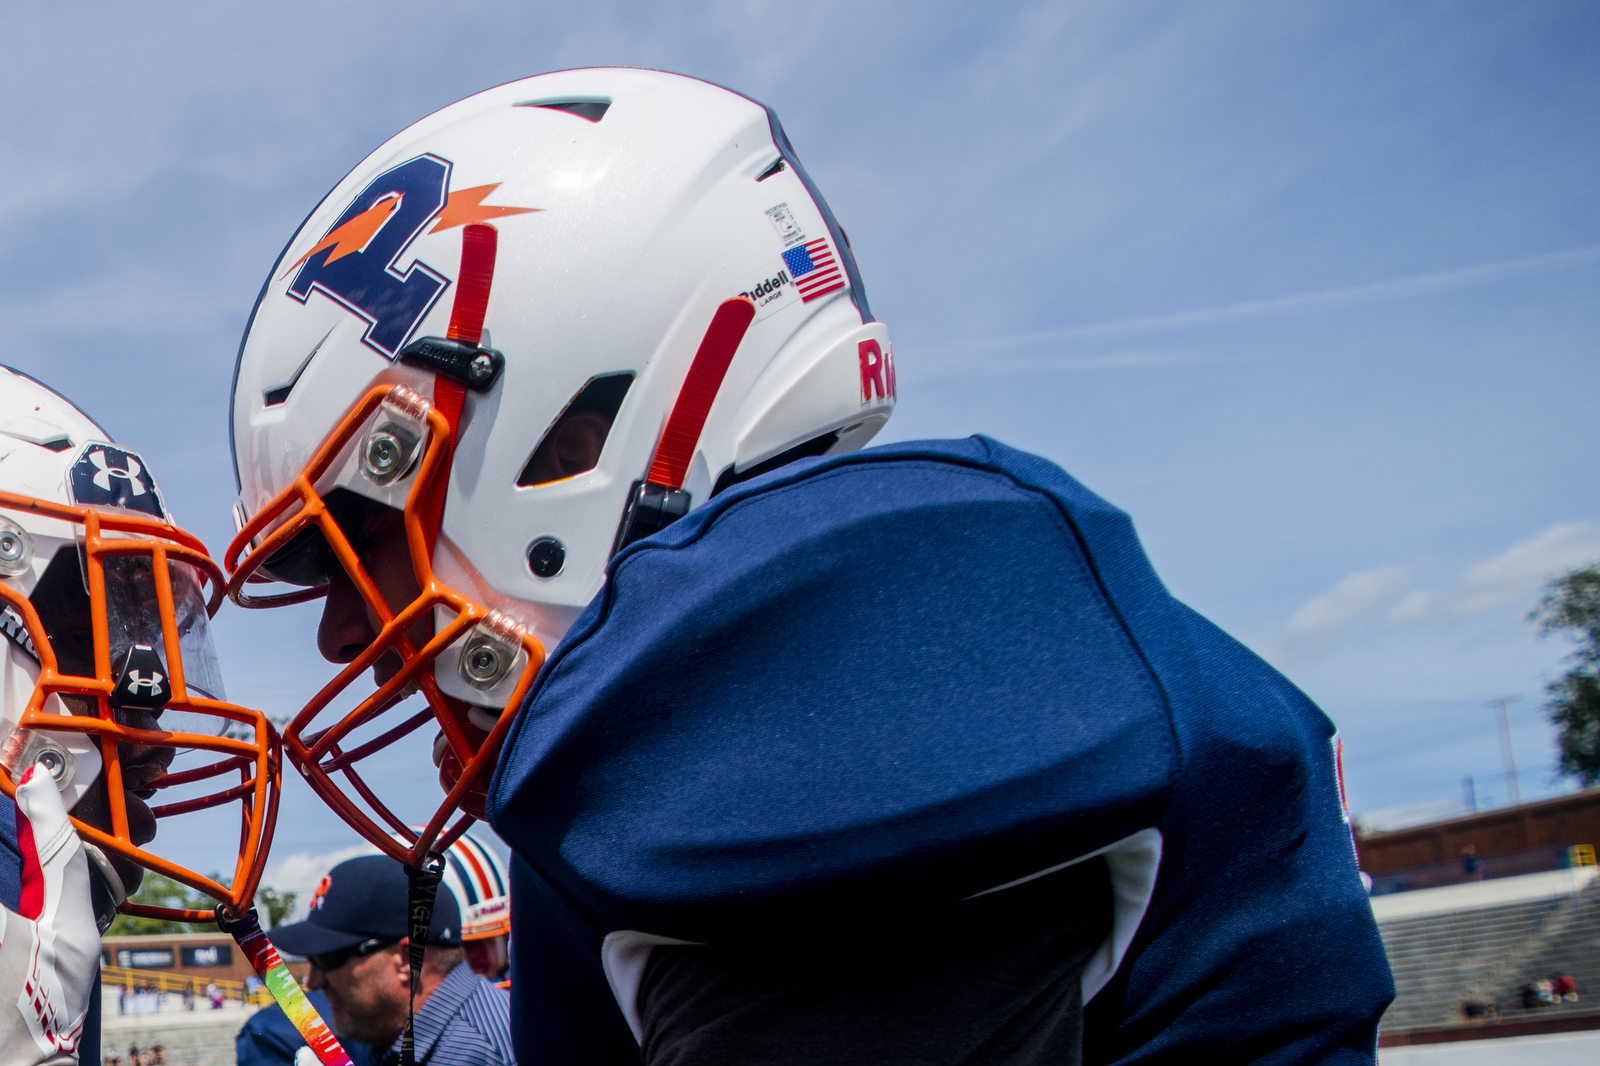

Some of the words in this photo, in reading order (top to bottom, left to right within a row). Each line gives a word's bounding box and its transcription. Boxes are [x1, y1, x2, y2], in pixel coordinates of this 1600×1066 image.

[286, 153, 453, 362] P
[759, 290, 784, 308] LARGE
[419, 342, 465, 367] Ridde
